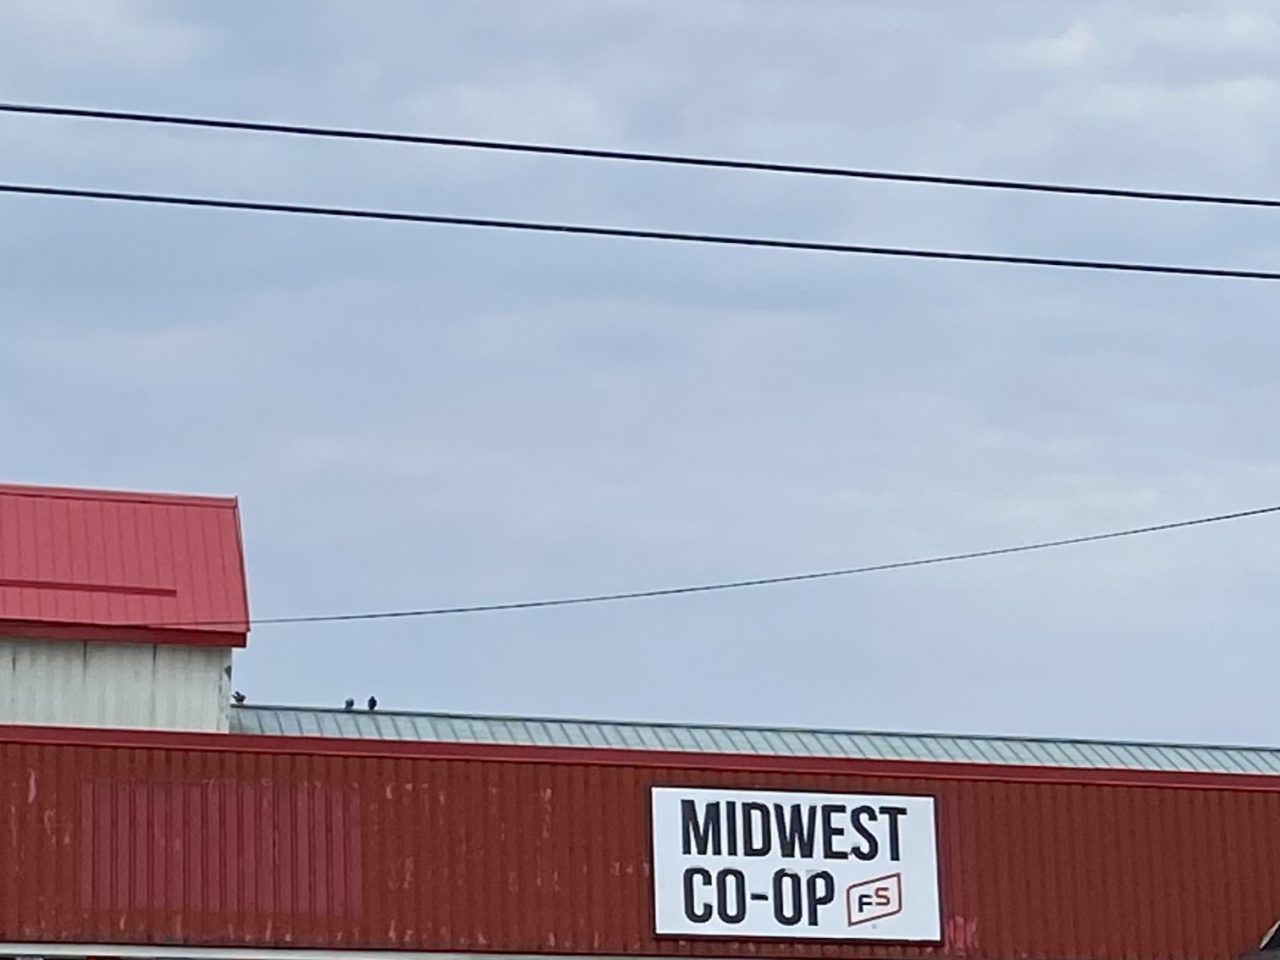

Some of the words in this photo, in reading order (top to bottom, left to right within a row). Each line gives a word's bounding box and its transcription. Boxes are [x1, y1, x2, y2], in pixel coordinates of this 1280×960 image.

[680, 799, 908, 861] MIDWEST
[683, 867, 835, 926] CO-OP
[858, 887, 890, 914] FS
